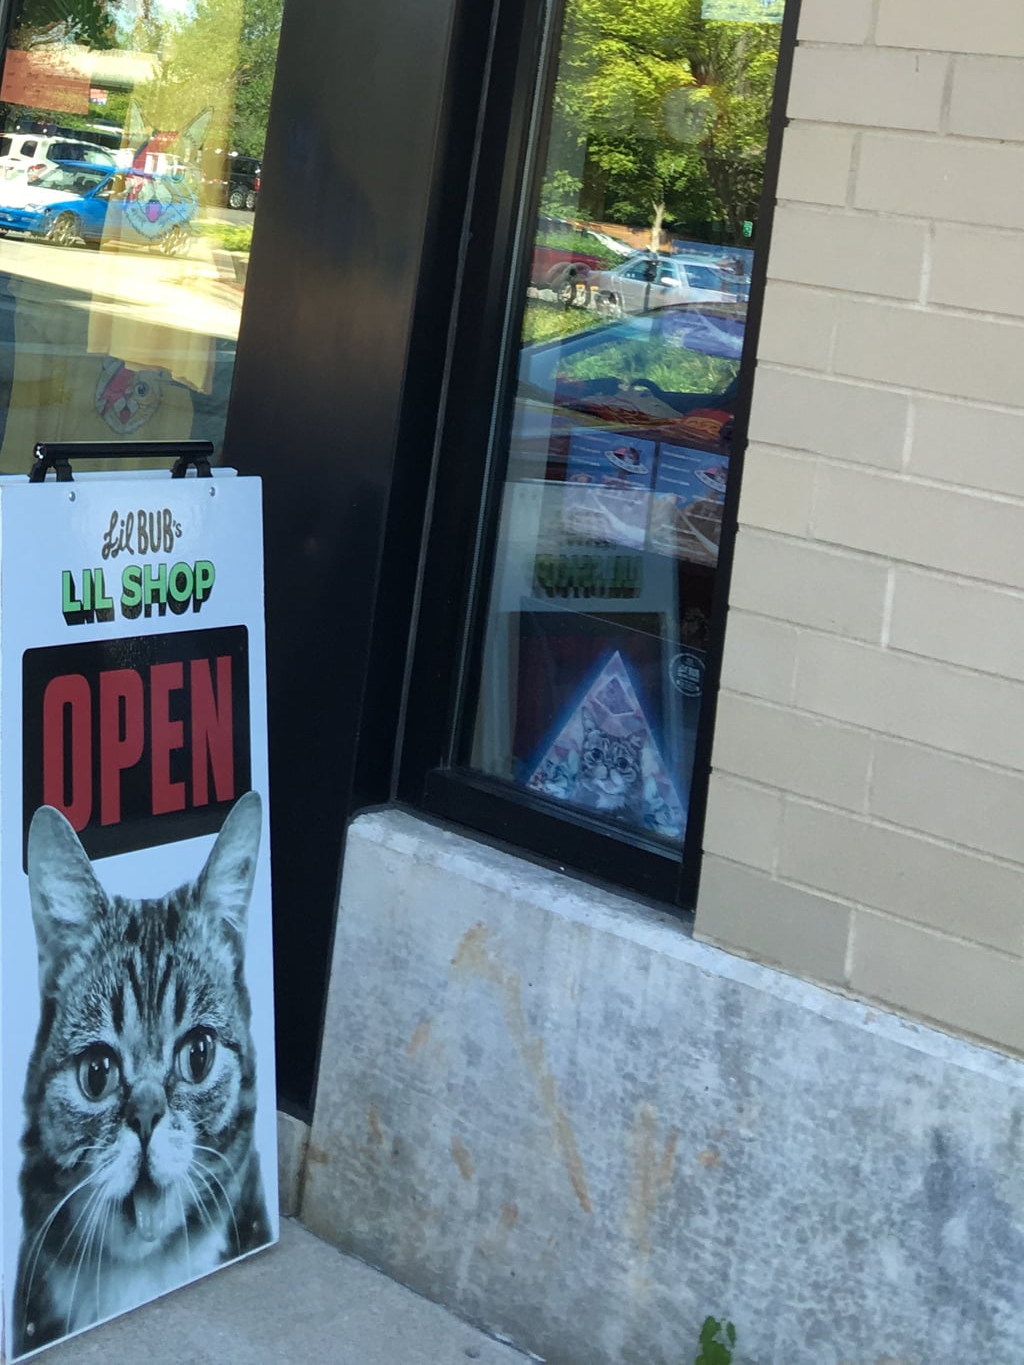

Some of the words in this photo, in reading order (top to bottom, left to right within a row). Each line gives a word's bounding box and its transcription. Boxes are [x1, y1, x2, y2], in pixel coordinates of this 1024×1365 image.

[101, 510, 134, 559] Lil
[137, 508, 182, 555] BUB's
[62, 567, 115, 626] LIL
[120, 560, 216, 619] SHOP
[42, 656, 235, 834] OPEN
